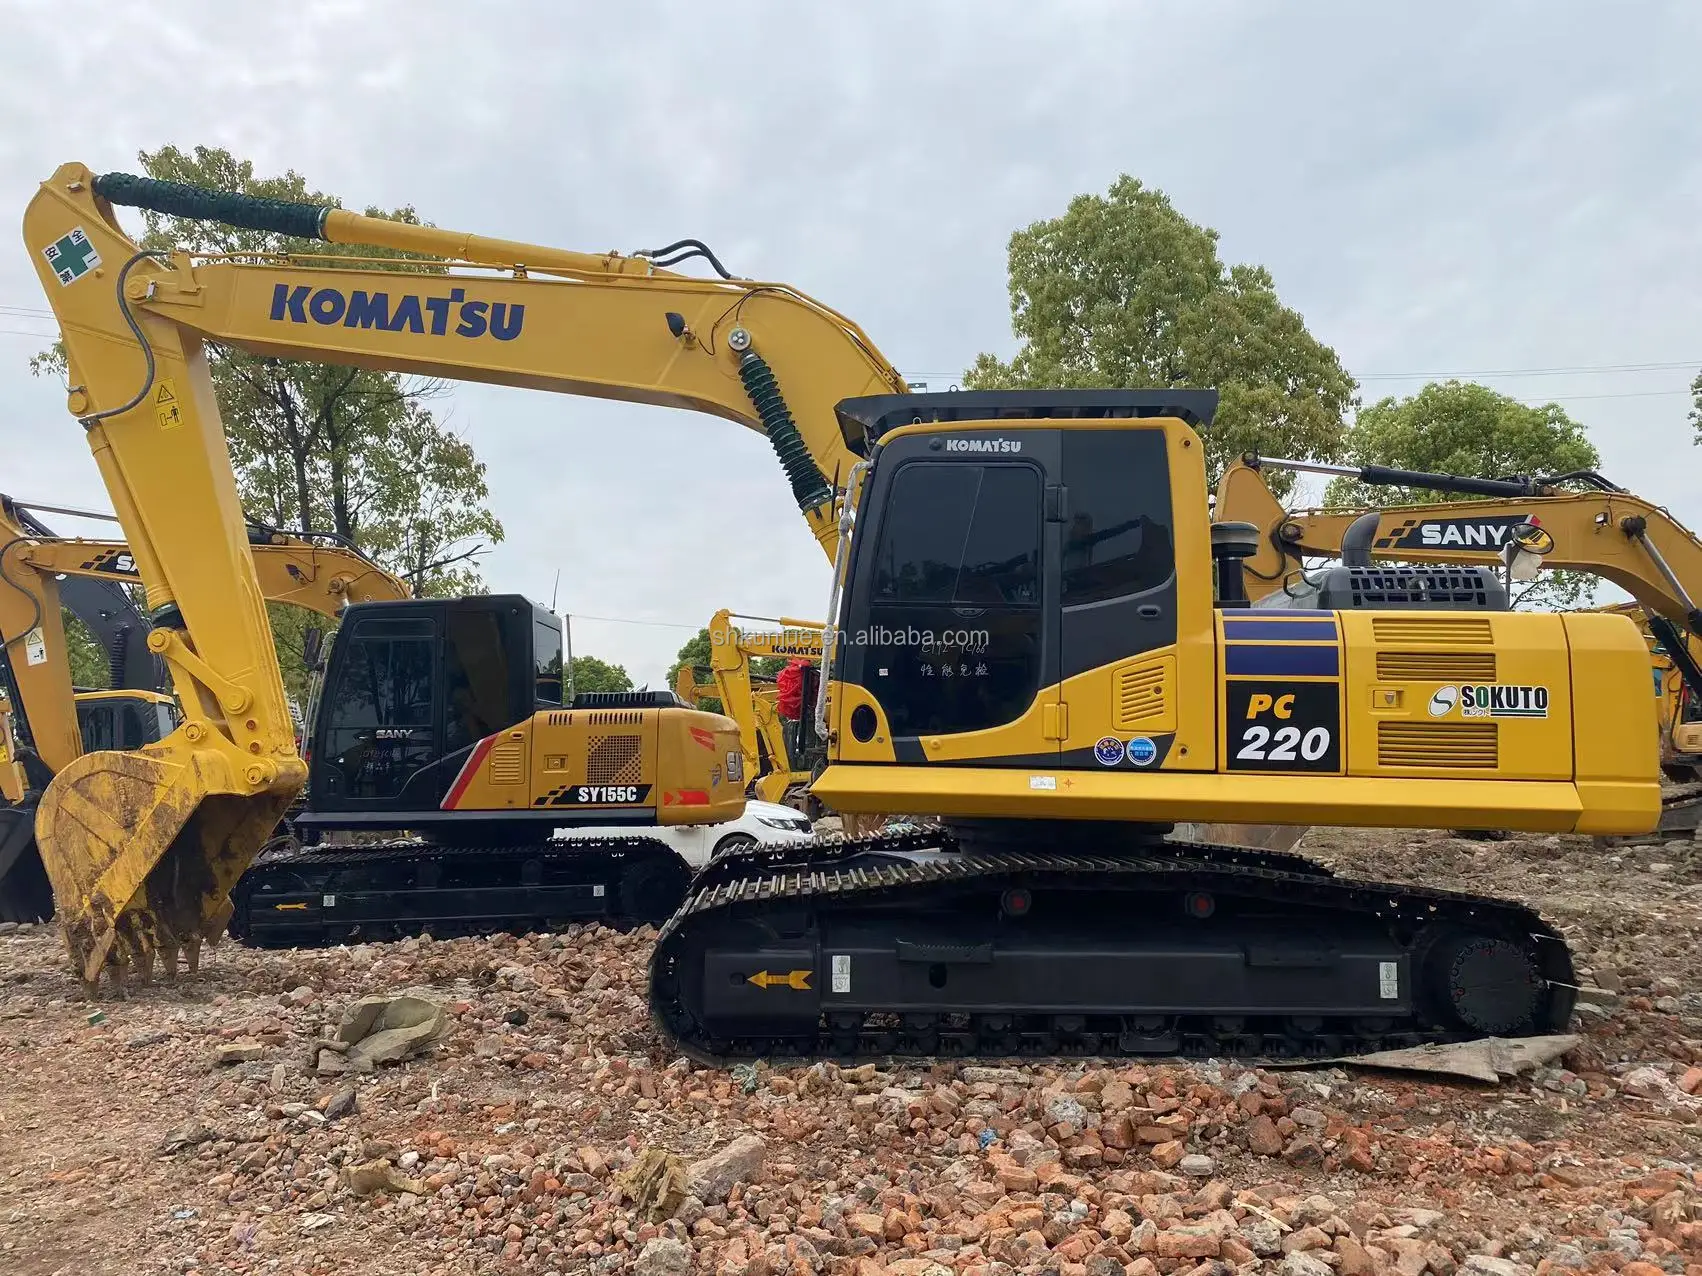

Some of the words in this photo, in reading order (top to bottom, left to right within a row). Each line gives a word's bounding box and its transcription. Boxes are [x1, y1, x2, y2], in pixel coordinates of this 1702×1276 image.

[269, 283, 525, 341] KOMATSU
[945, 437, 1022, 453] KOMATSU
[1421, 524, 1508, 546] SANY
[772, 644, 823, 656] KOMATSU
[1246, 693, 1296, 719] PC
[1461, 685, 1548, 709] SOKUTO
[376, 729, 413, 739] SANY
[1236, 725, 1331, 761] 220
[578, 786, 638, 802] SY155C
